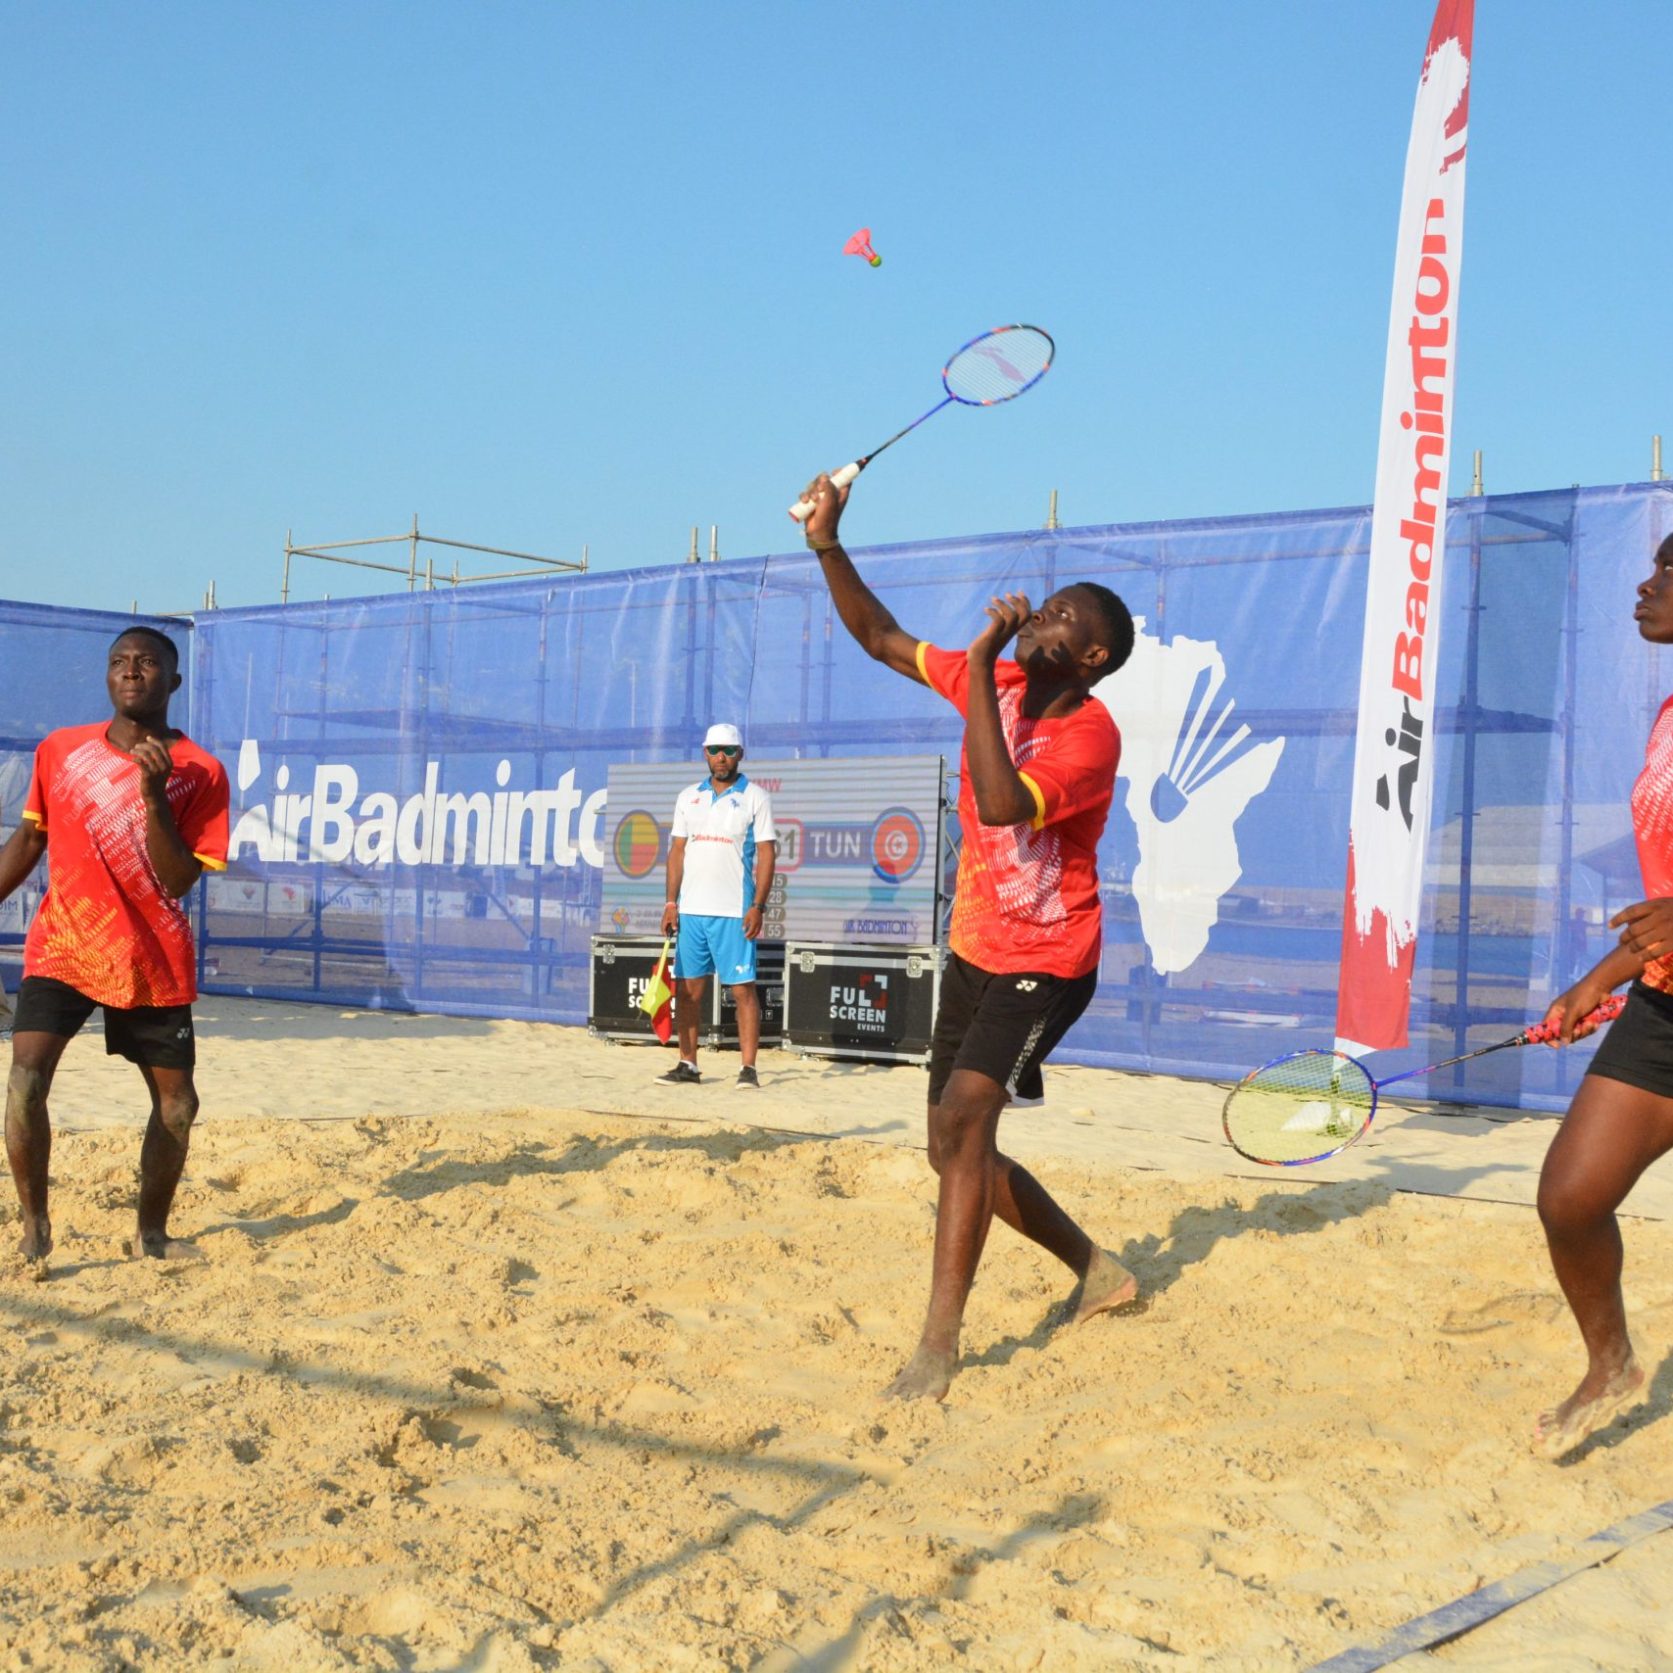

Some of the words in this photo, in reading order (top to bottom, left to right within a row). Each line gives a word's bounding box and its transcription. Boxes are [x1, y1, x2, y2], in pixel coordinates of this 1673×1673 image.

[810, 831, 860, 859] TUN
[769, 891, 782, 904] 28
[768, 908, 781, 920] 47
[768, 925, 781, 937] 55
[829, 1005, 887, 1024] SCREEN
[857, 1023, 885, 1033] EVENTS
